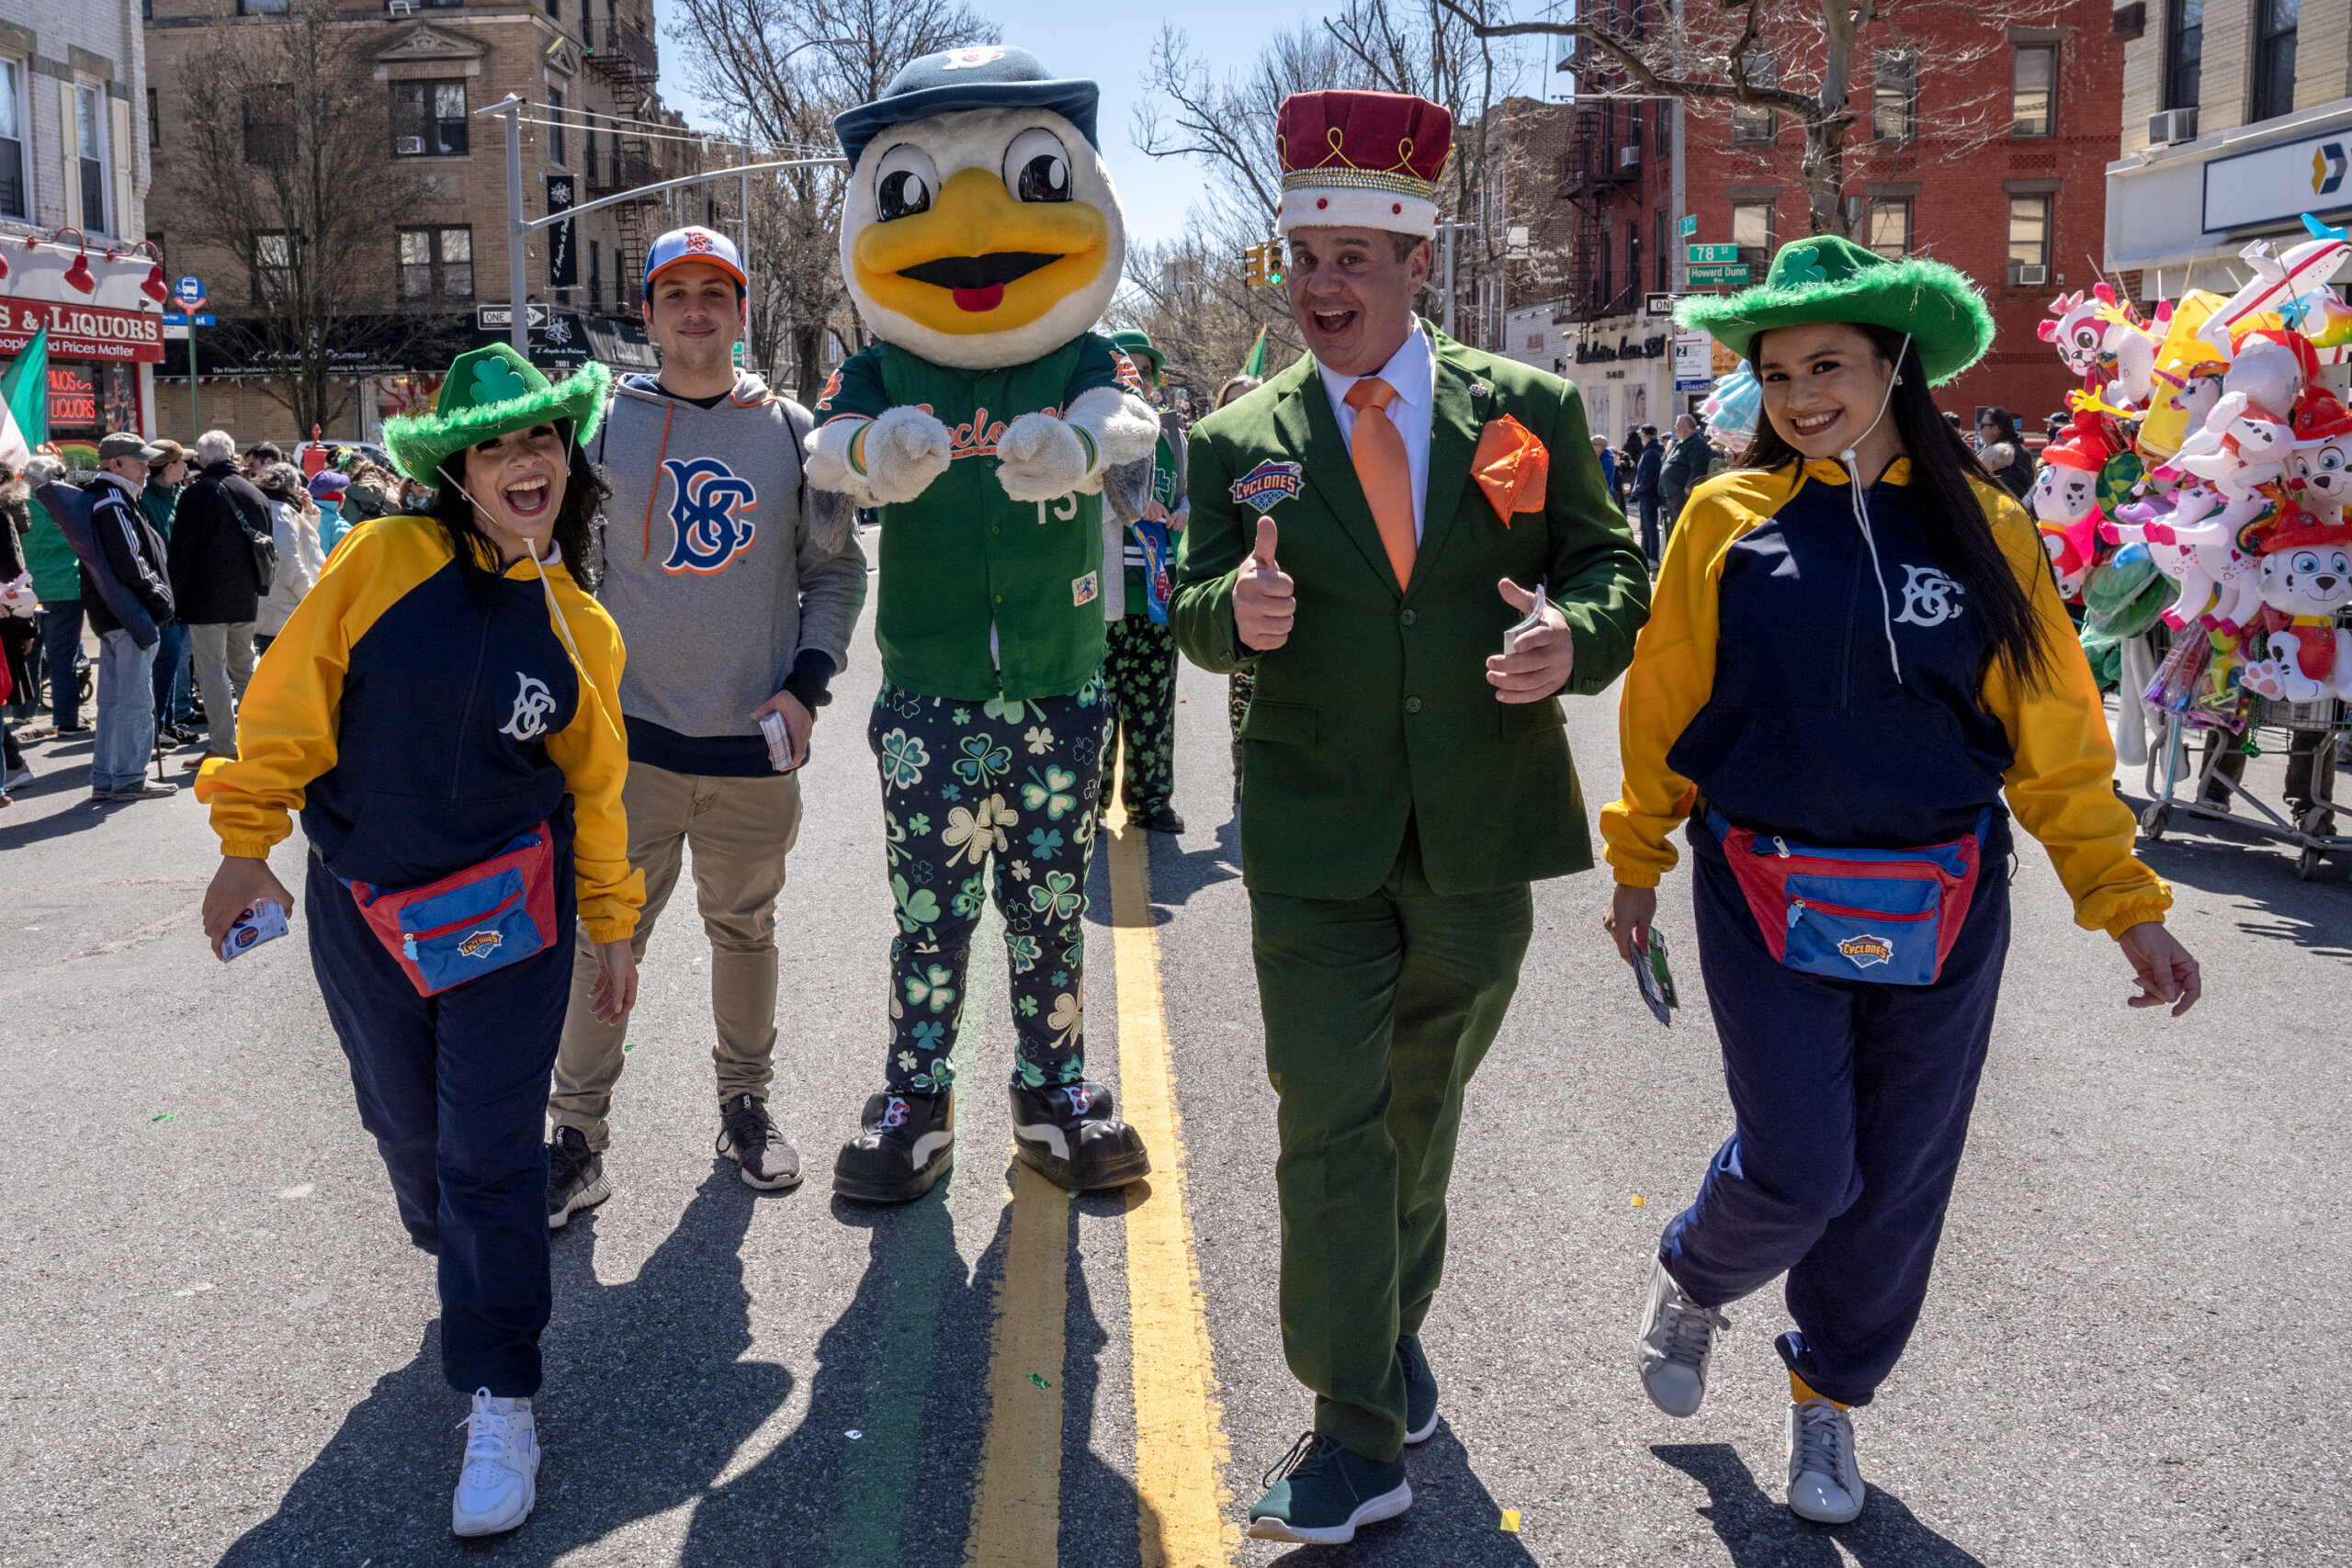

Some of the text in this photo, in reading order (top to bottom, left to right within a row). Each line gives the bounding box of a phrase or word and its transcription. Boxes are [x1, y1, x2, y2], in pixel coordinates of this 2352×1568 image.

[1697, 246, 1714, 261] 78
[1691, 267, 1747, 277] Howard Dunn
[22, 310, 39, 331] &
[50, 306, 158, 341] LIQUORS
[486, 313, 505, 321] ONE
[62, 342, 96, 354] Prices
[98, 344, 134, 356] Matter
[1679, 347, 1685, 356] 2
[51, 399, 96, 418] LIQUORS
[1236, 475, 1295, 499] CYCLONES
[661, 457, 758, 576] BC
[1893, 564, 1965, 627] BC
[498, 671, 556, 740] BC
[1843, 943, 1887, 959] CYCLONES
